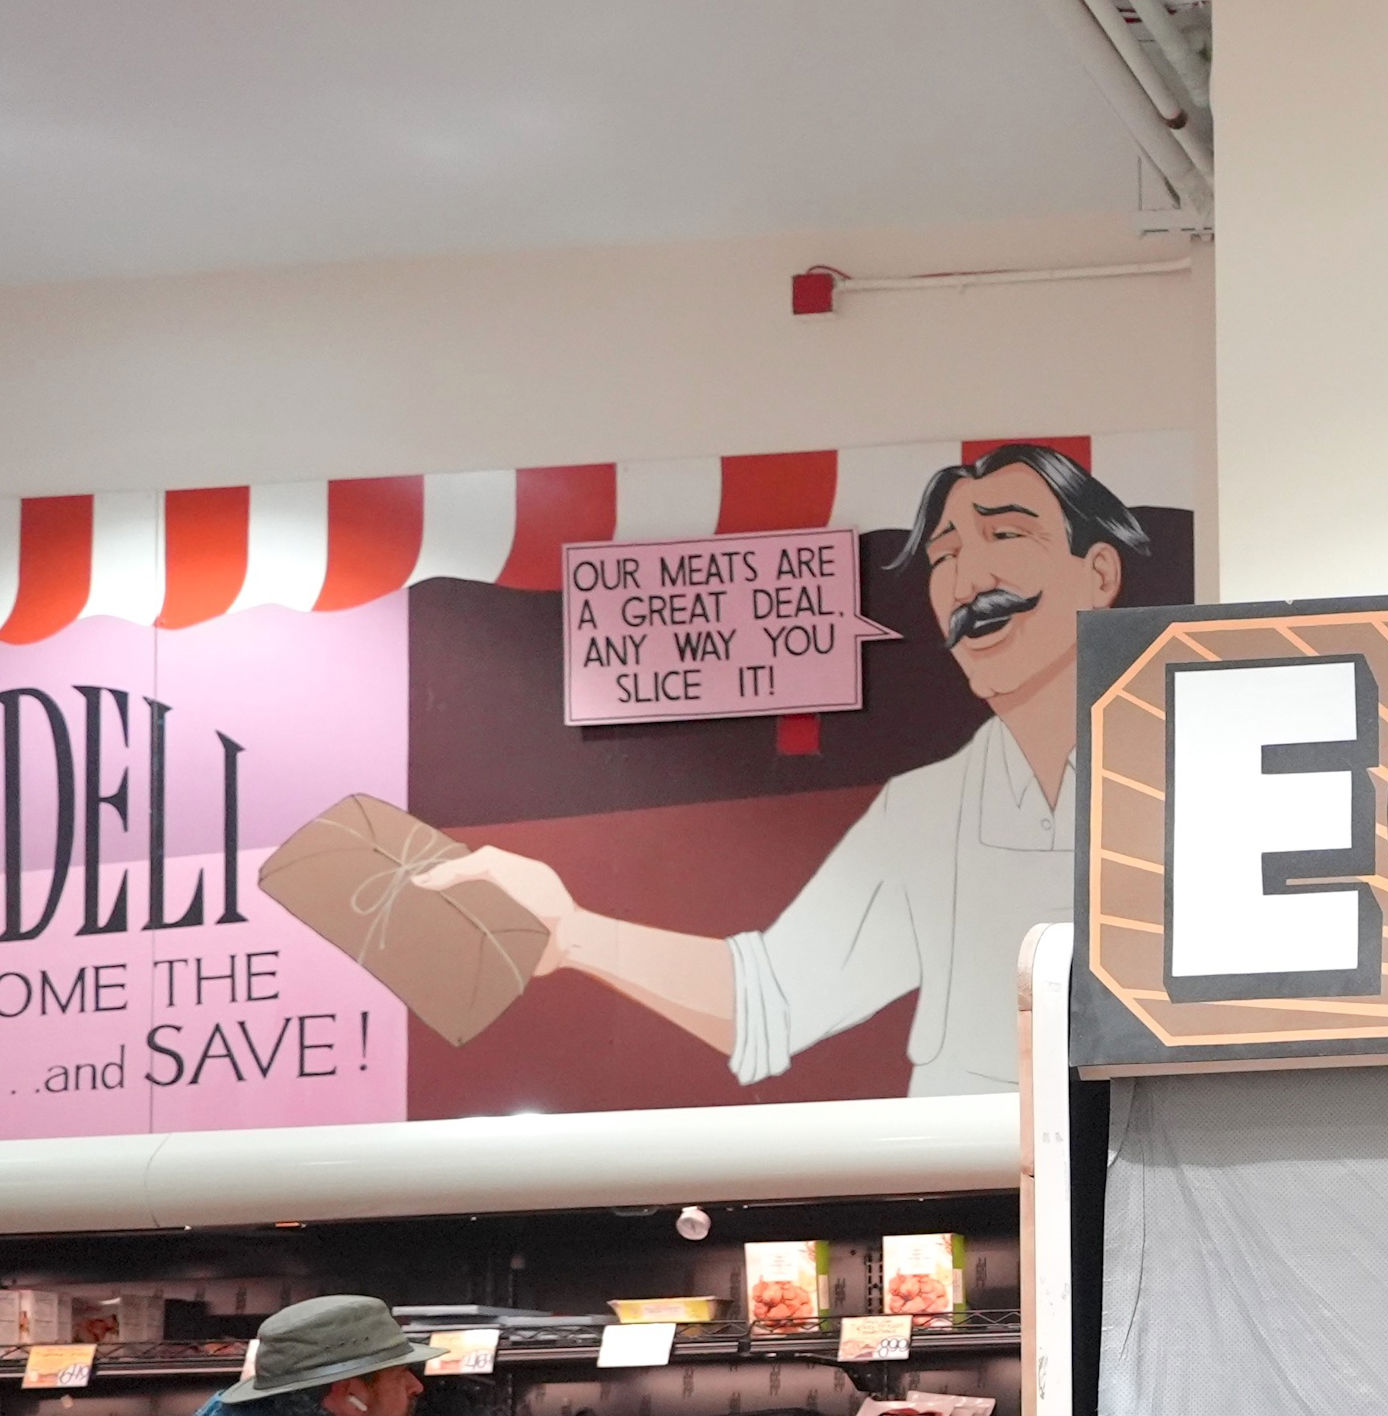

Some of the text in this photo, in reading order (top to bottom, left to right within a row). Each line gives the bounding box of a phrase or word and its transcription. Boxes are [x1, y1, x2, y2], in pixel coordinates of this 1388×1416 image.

[573, 546, 836, 592] OUR MEATS ARE
[577, 600, 598, 630] A
[622, 591, 728, 628] GREAT
[583, 624, 836, 668] ANY WAY YOU
[616, 665, 776, 703] SLICE IT!
[2, 685, 247, 943] DELI
[154, 950, 281, 1008] THE
